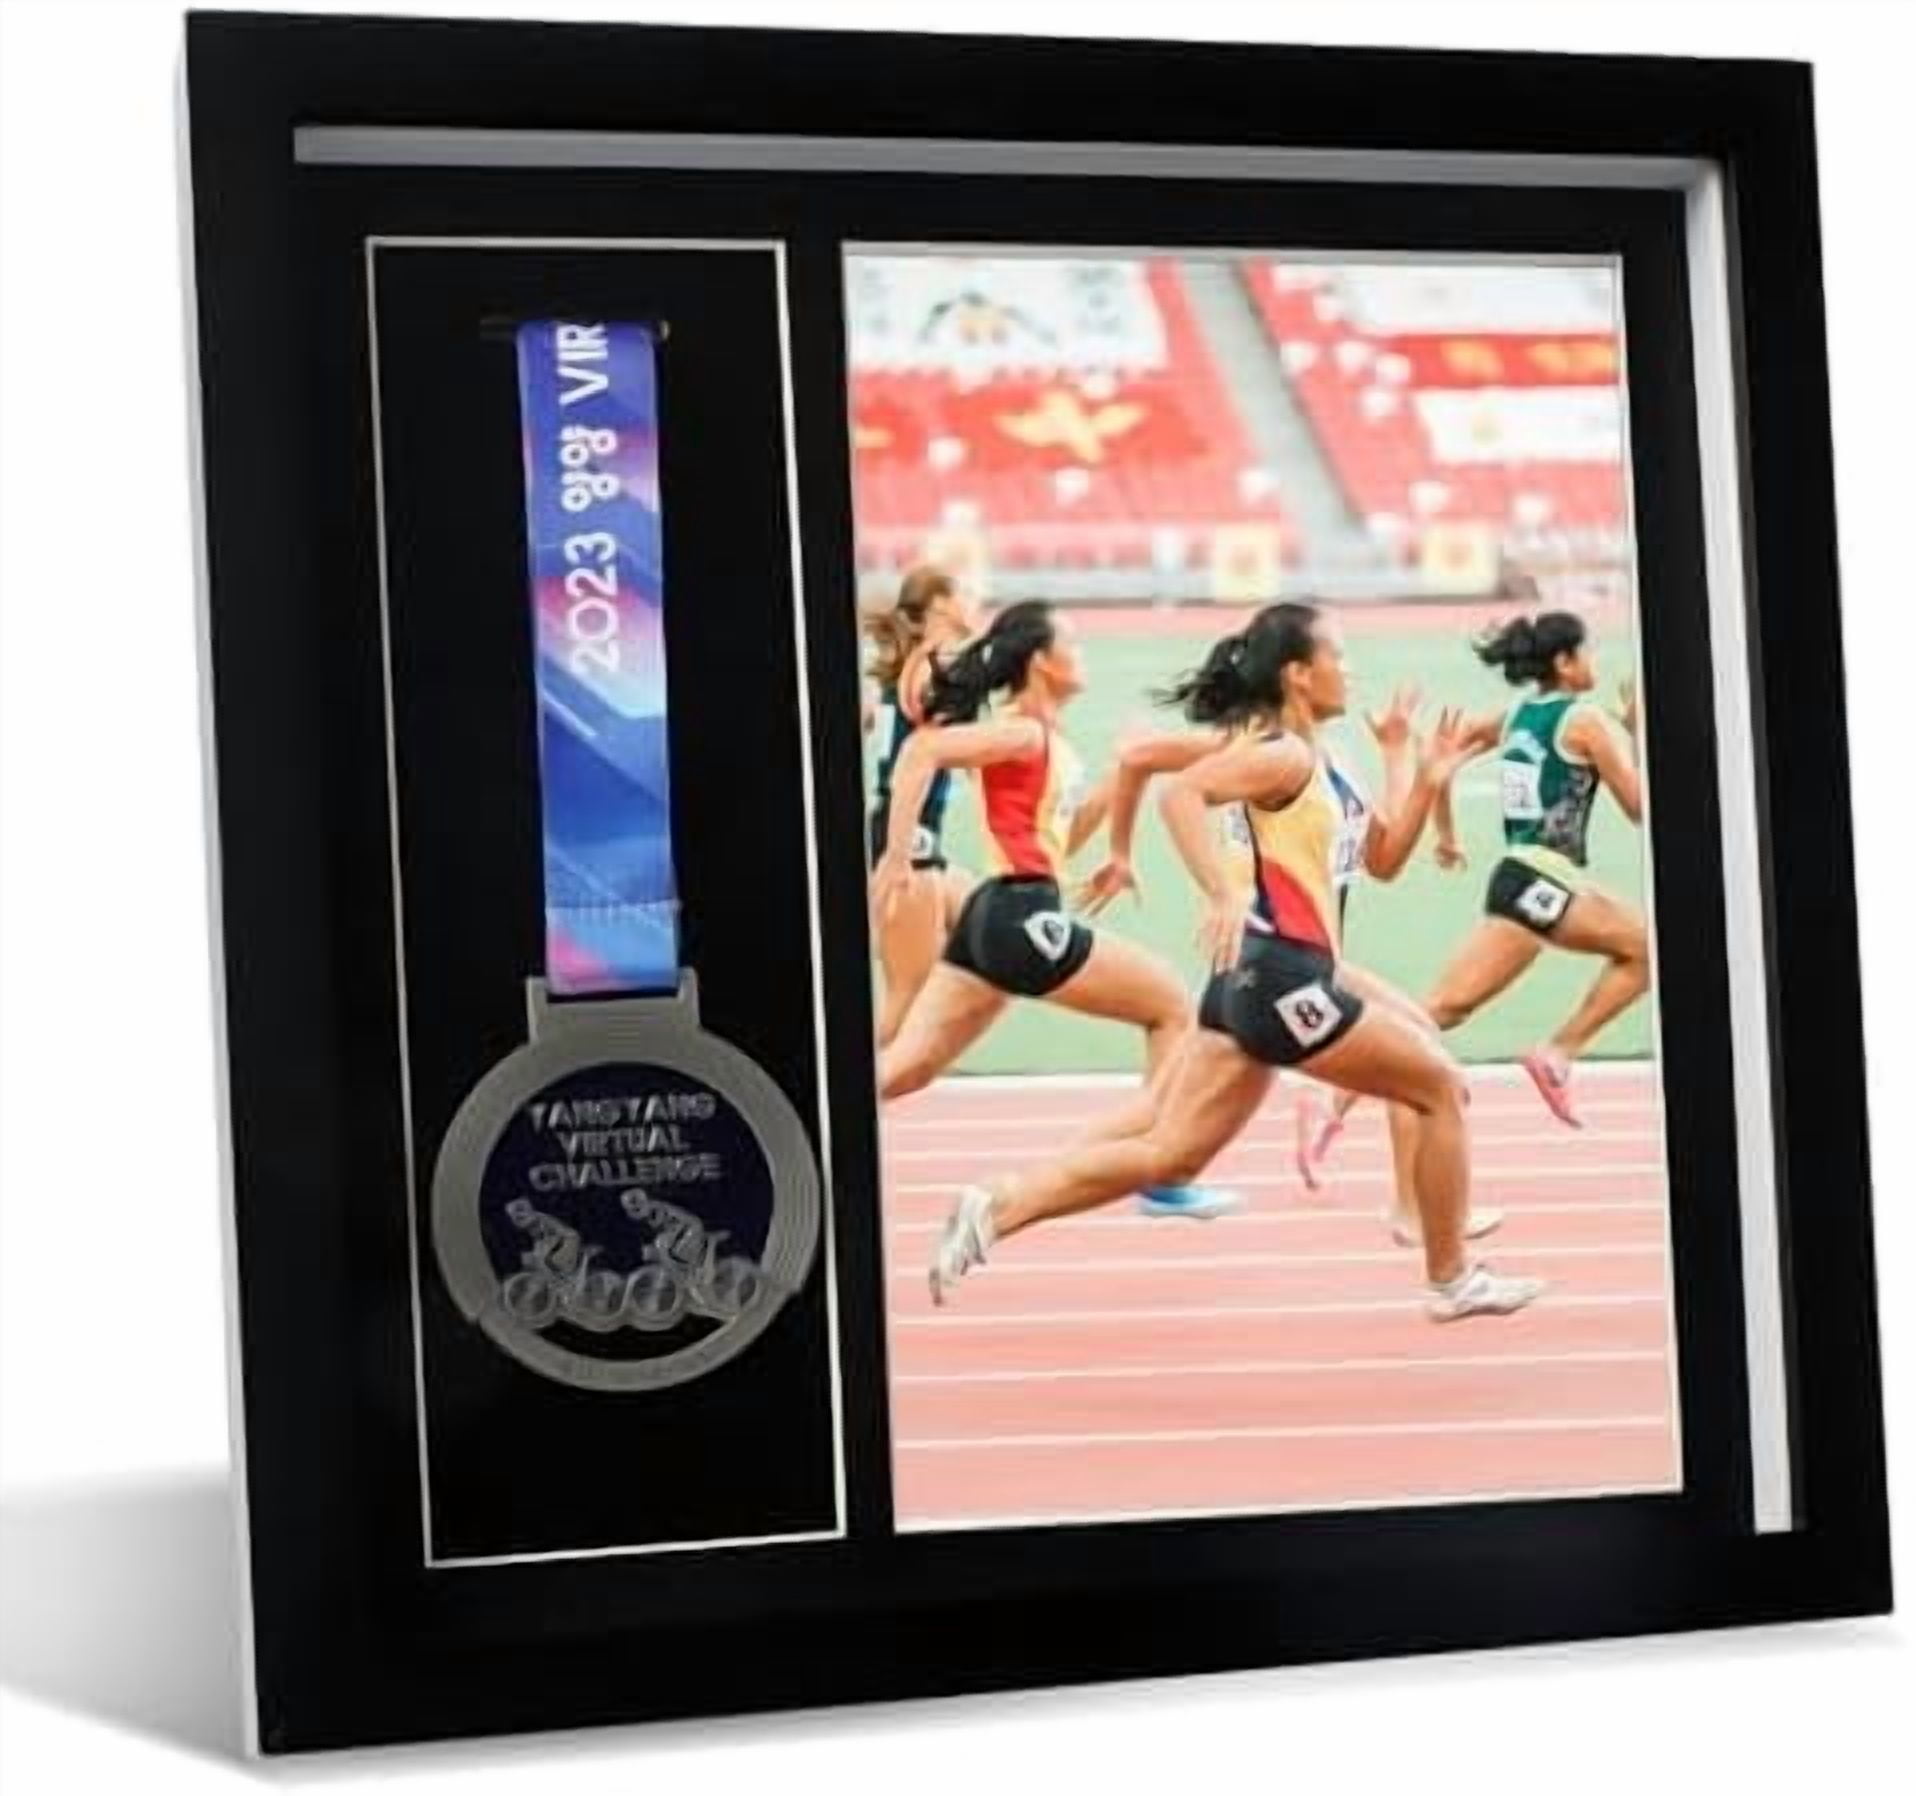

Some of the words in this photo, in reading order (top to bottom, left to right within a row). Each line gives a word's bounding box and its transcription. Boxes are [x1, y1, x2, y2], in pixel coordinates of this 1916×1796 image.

[557, 323, 609, 405] VIR
[560, 425, 620, 512] 양양
[564, 531, 620, 673] 2023
[530, 1154, 721, 1190] CHALLENGE
[558, 1126, 690, 1157] VIRTUAL
